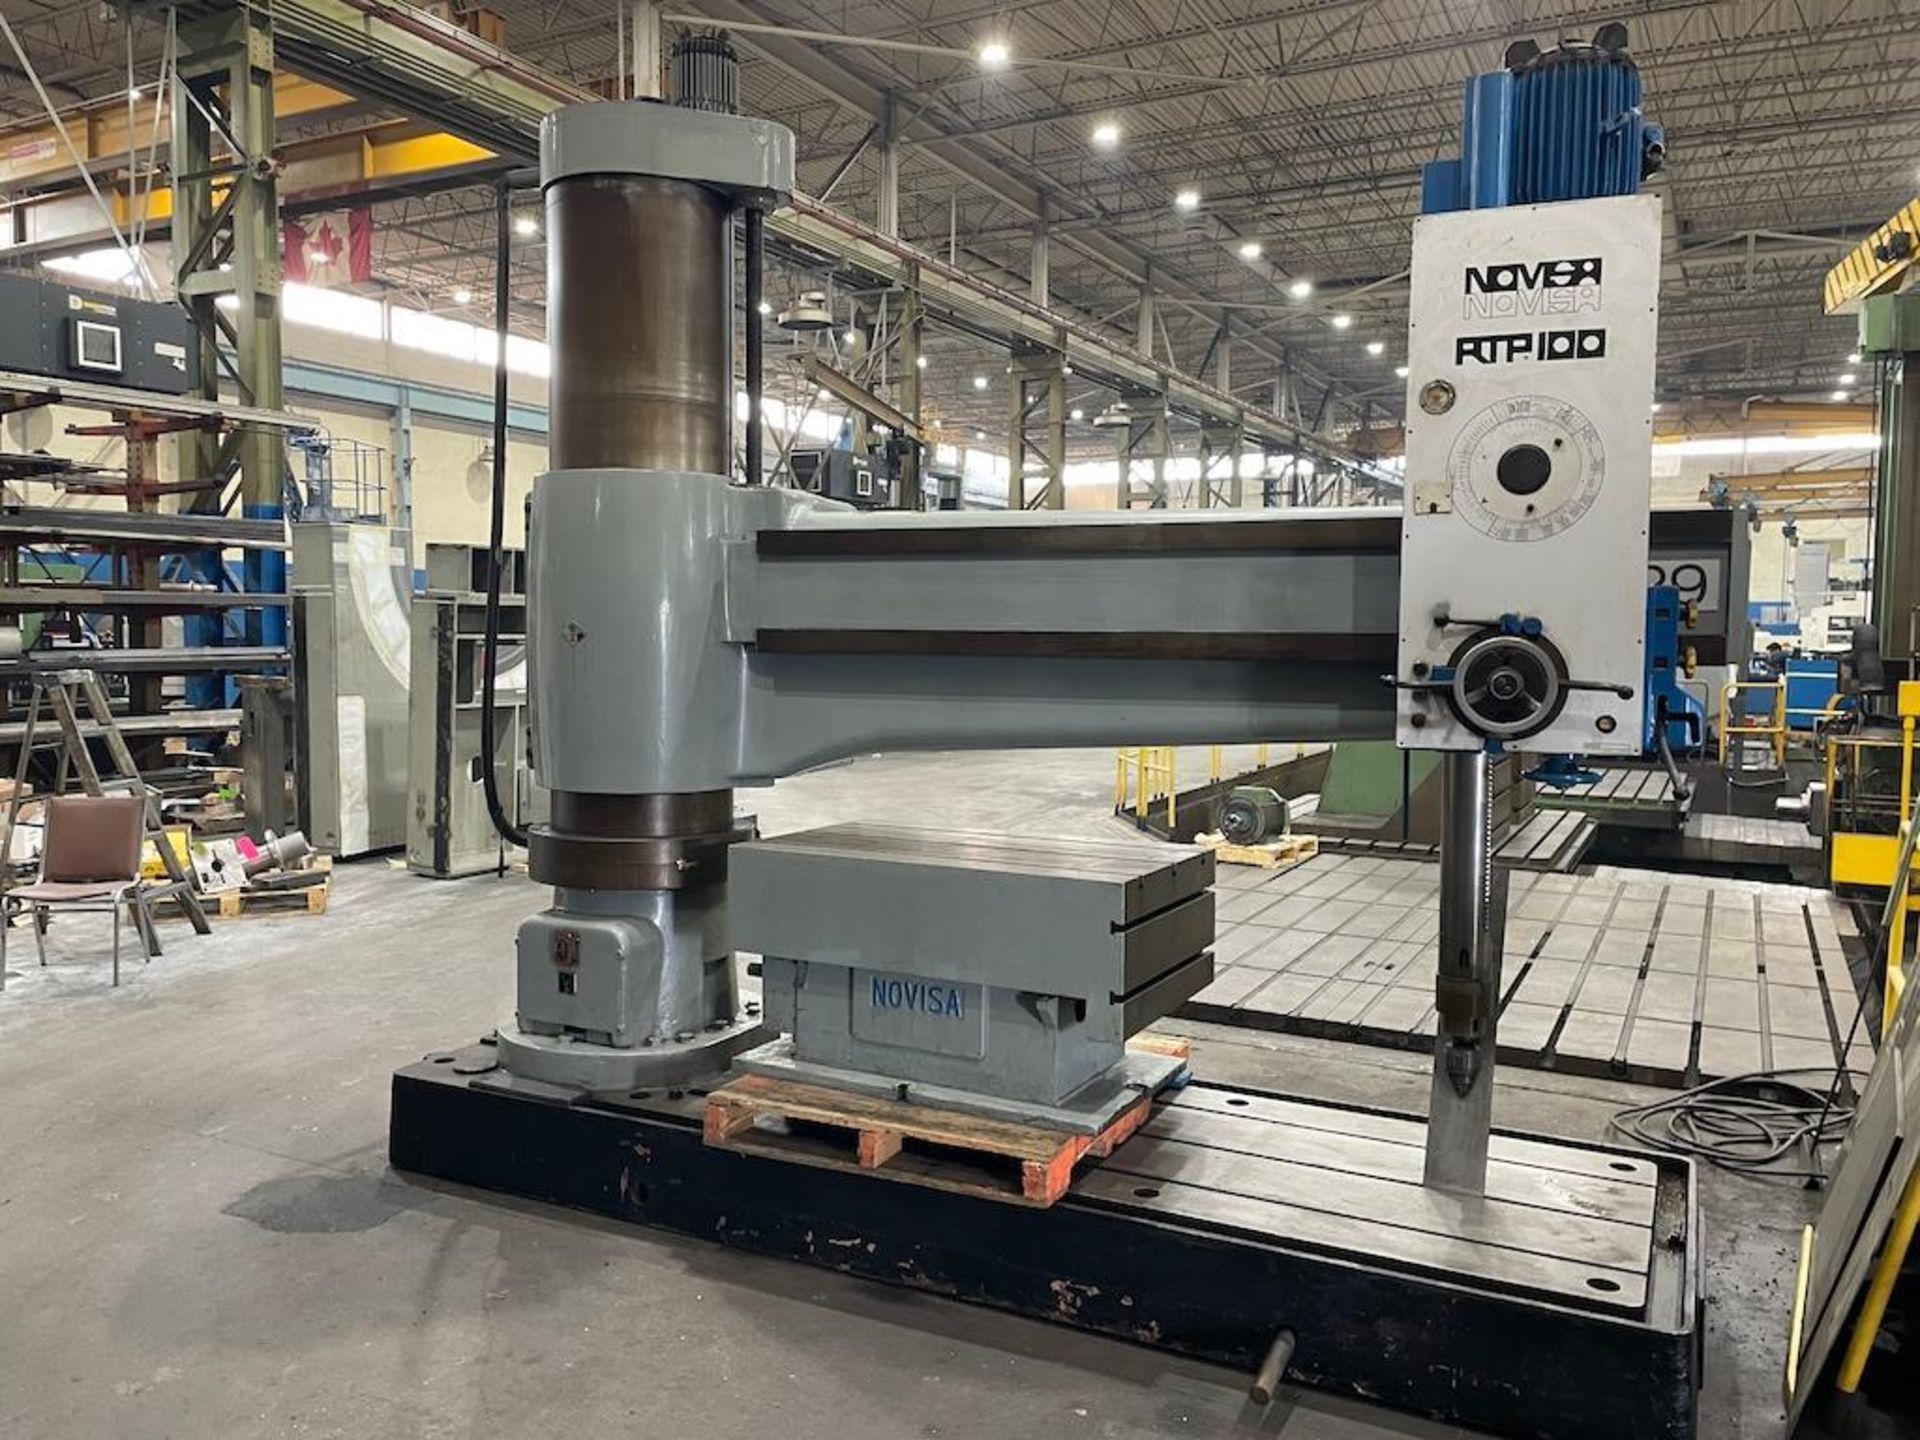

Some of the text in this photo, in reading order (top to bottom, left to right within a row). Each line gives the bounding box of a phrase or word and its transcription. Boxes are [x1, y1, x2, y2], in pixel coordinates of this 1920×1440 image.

[1465, 257, 1602, 295] NOVISA
[1463, 284, 1602, 320] NOVISA
[871, 976, 962, 1018] NOVISA
